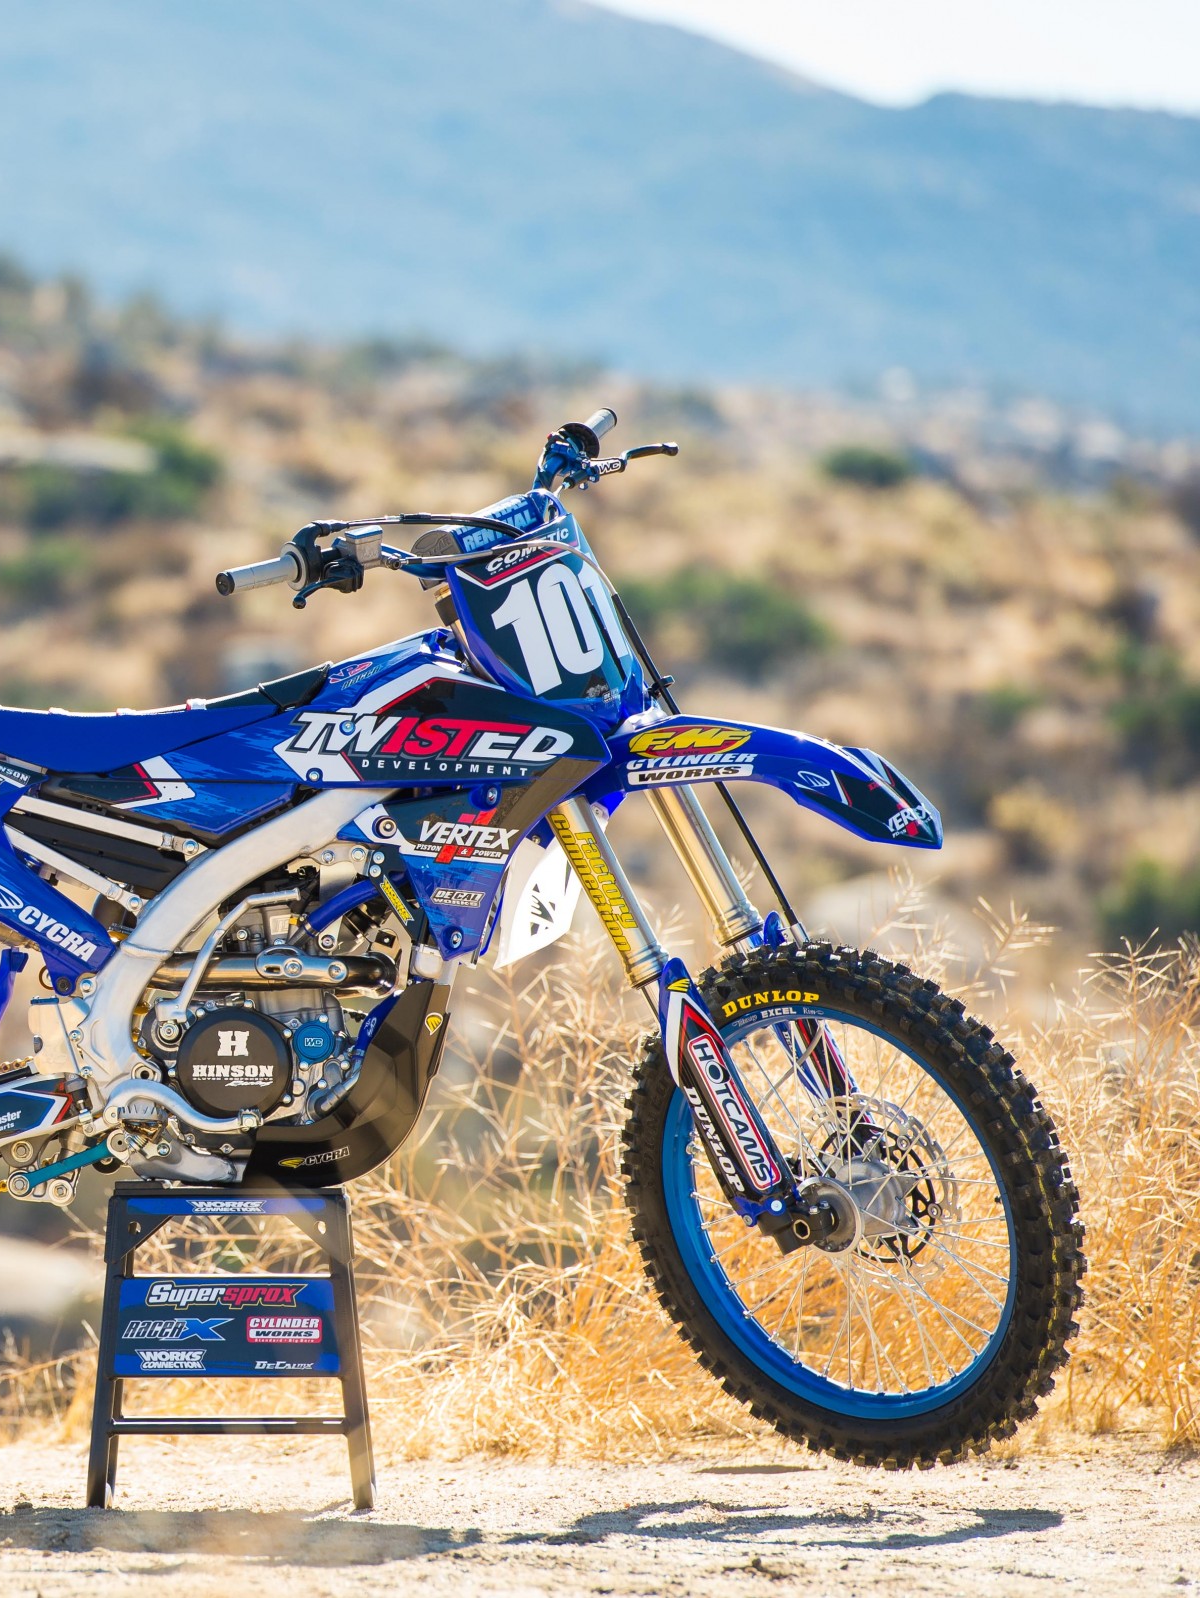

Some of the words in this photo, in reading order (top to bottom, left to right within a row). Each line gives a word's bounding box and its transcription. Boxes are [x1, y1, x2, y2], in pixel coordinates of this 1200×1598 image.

[490, 551, 629, 696] 101
[297, 712, 574, 762] TWISTED
[629, 728, 753, 753] FMF
[362, 758, 529, 777] DEVELOPMENT
[626, 752, 758, 770] CYLINDER
[638, 765, 742, 782] WORKS
[419, 820, 520, 850] VERTEX
[416, 843, 442, 852] PISTON
[472, 849, 502, 858] POWER
[17, 905, 98, 963] CYCRA
[721, 989, 820, 1018] DUNLOP
[761, 1006, 797, 1019] EXCEL
[192, 1064, 274, 1078] HINSON
[683, 1085, 746, 1193] DUNLOP
[305, 1146, 350, 1165] CYCRA
[148, 1284, 297, 1307] Supersprox
[249, 1318, 320, 1328] CYLINDER
[255, 1330, 314, 1338] WORKS
[139, 1351, 203, 1361] WORKS
[142, 1361, 203, 1369] CONNECTION
